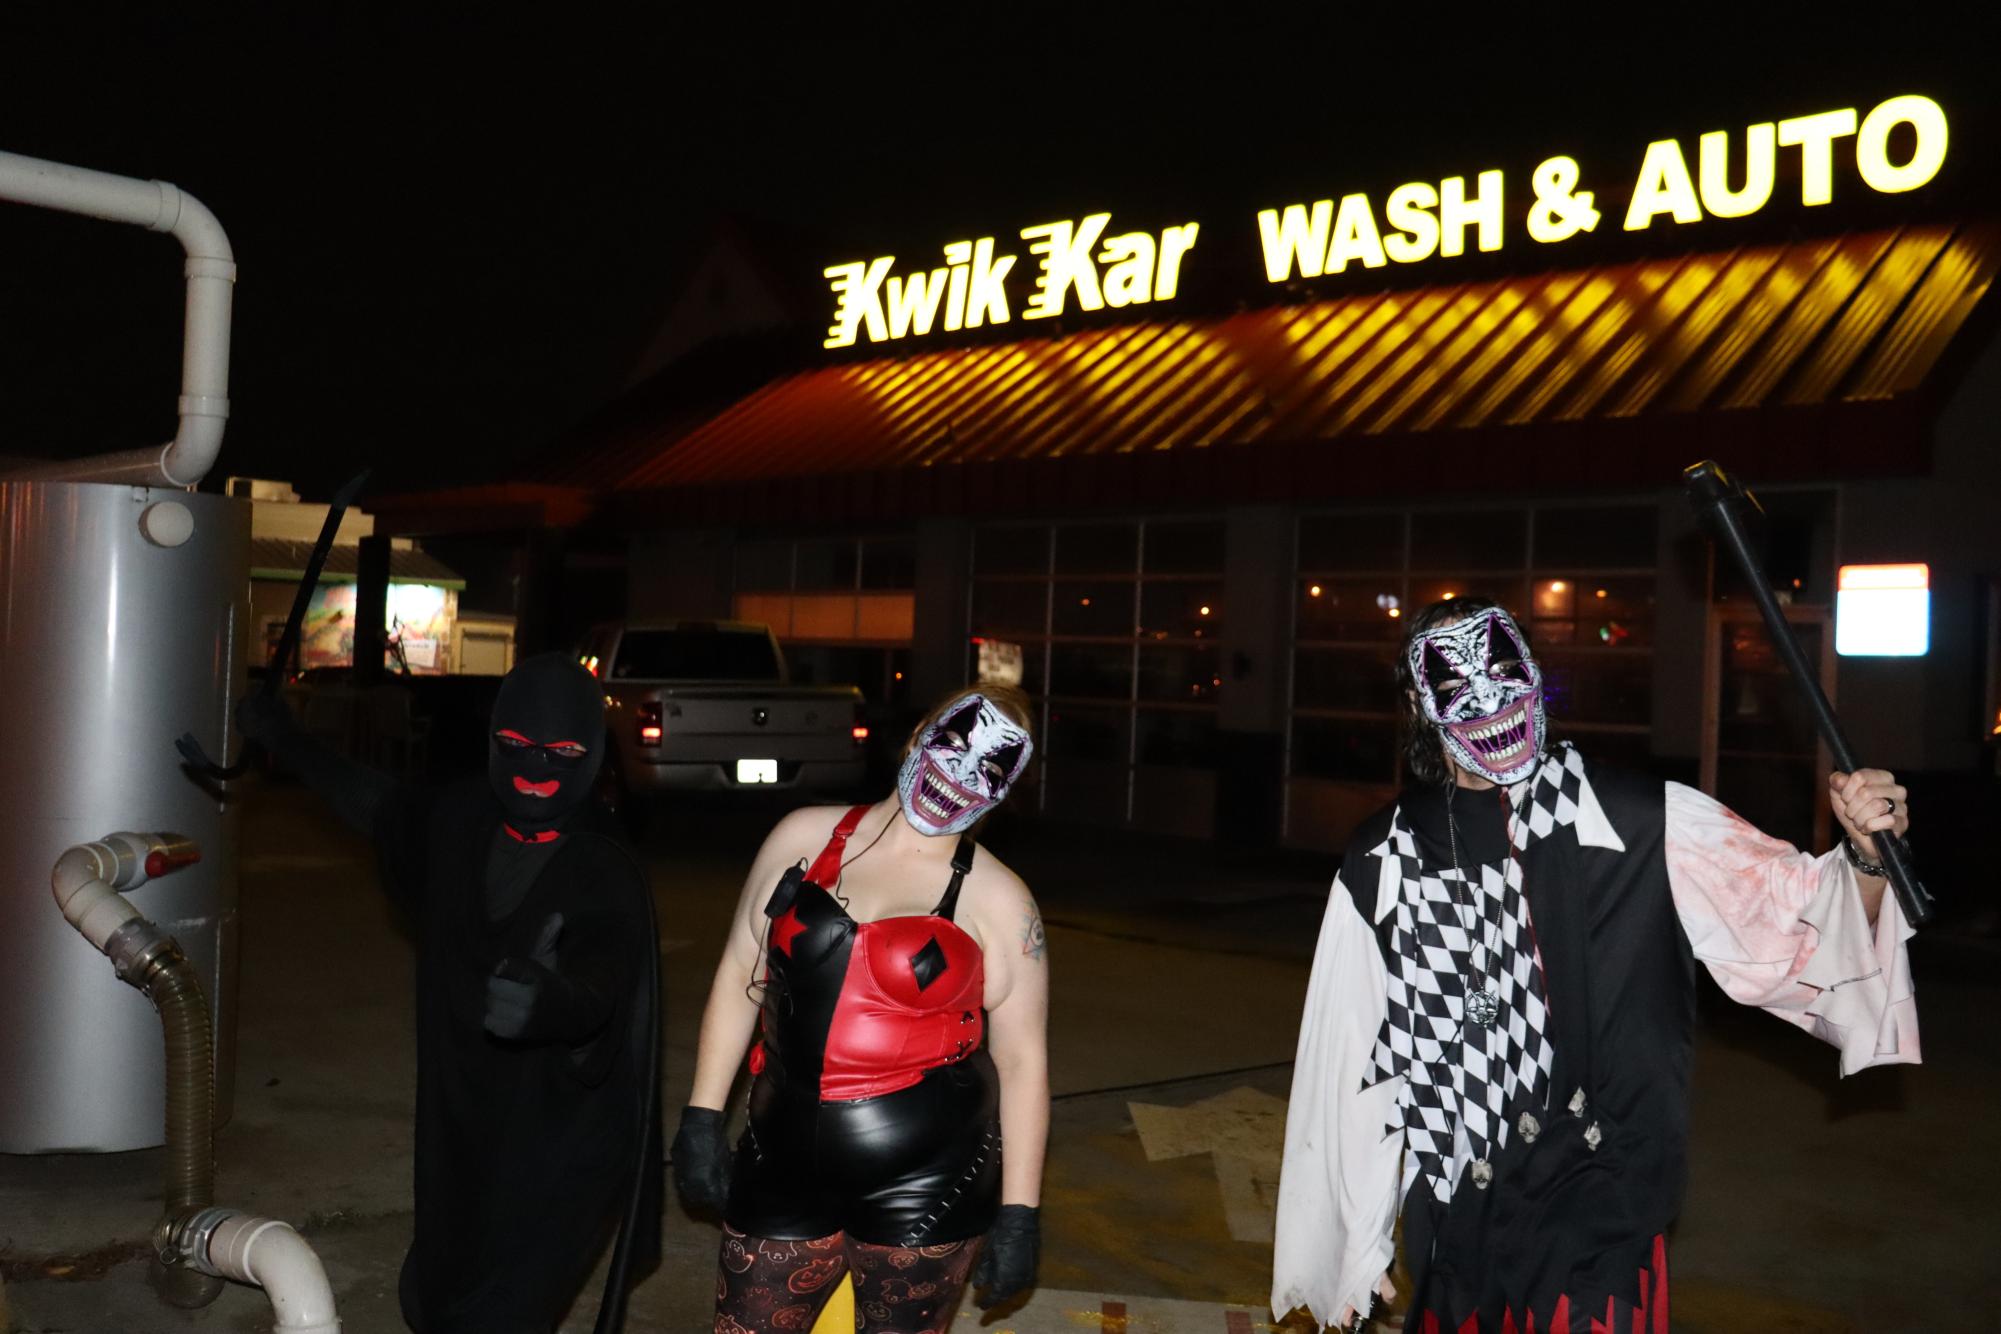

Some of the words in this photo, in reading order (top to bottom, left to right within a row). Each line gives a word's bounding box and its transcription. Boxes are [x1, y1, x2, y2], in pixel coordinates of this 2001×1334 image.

[823, 237, 1018, 349] Kwik
[1019, 212, 1201, 320] Kar
[1257, 168, 1505, 283] WASH
[1526, 156, 1601, 243] &
[1623, 94, 1949, 232] AUTO
